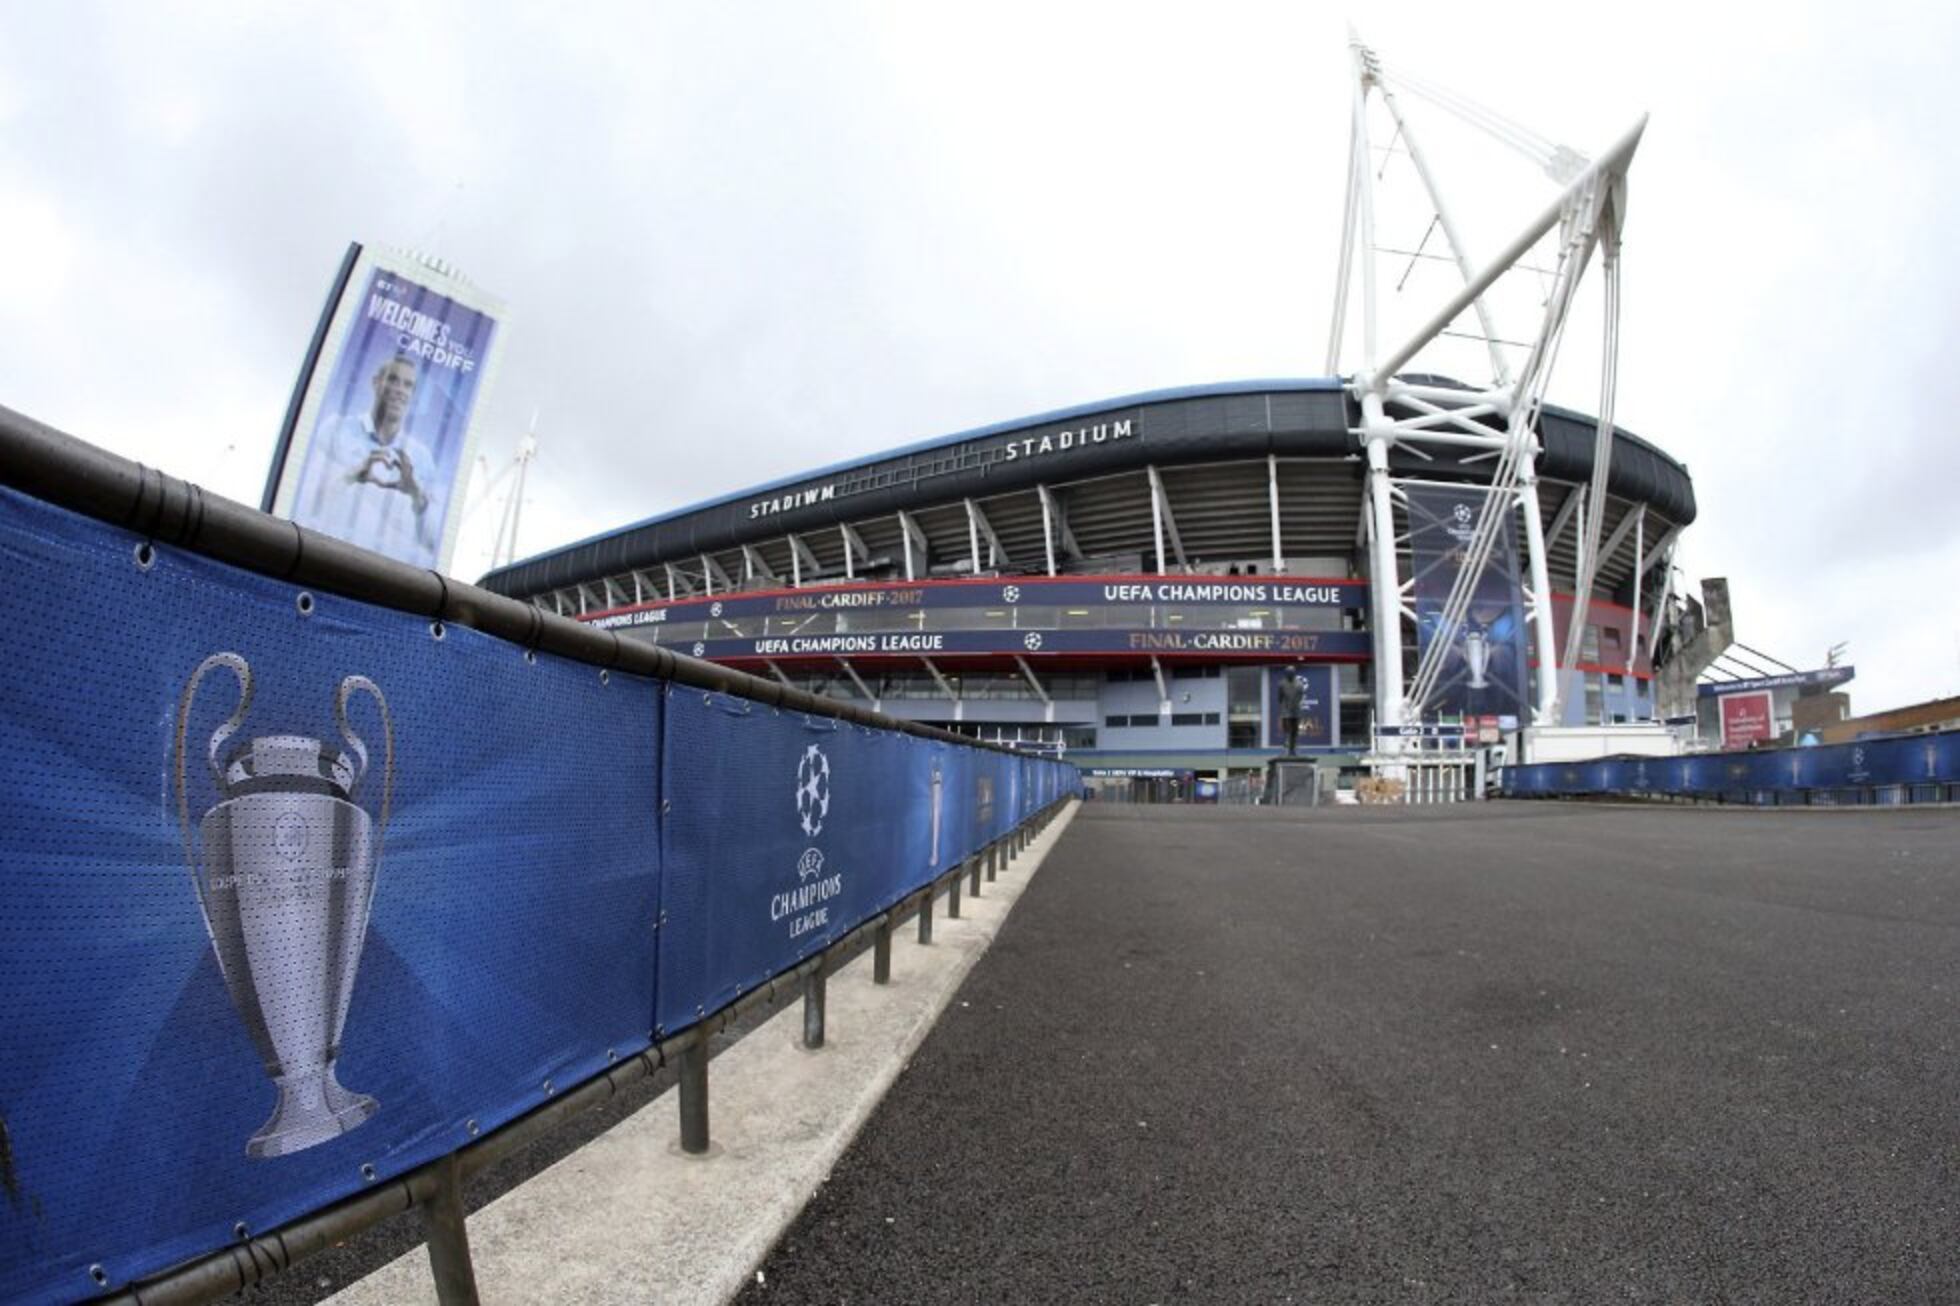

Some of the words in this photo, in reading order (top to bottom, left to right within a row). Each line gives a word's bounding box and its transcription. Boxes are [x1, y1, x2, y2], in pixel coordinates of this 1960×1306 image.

[368, 294, 451, 347] WELCOMES
[397, 334, 475, 372] CARDIFF
[1005, 419, 1131, 461] STADIUM
[750, 484, 834, 519] STADIWM
[1104, 584, 1153, 601] UEFA
[1157, 585, 1267, 602] CHAMPIONS
[1272, 586, 1341, 603] LEAGUE
[755, 639, 789, 654] UEFA
[791, 636, 876, 653] CHAMPIONS
[881, 635, 943, 651] LEAGUE
[771, 873, 842, 921] CHAMPIONS
[789, 907, 829, 939] LEAGUE
